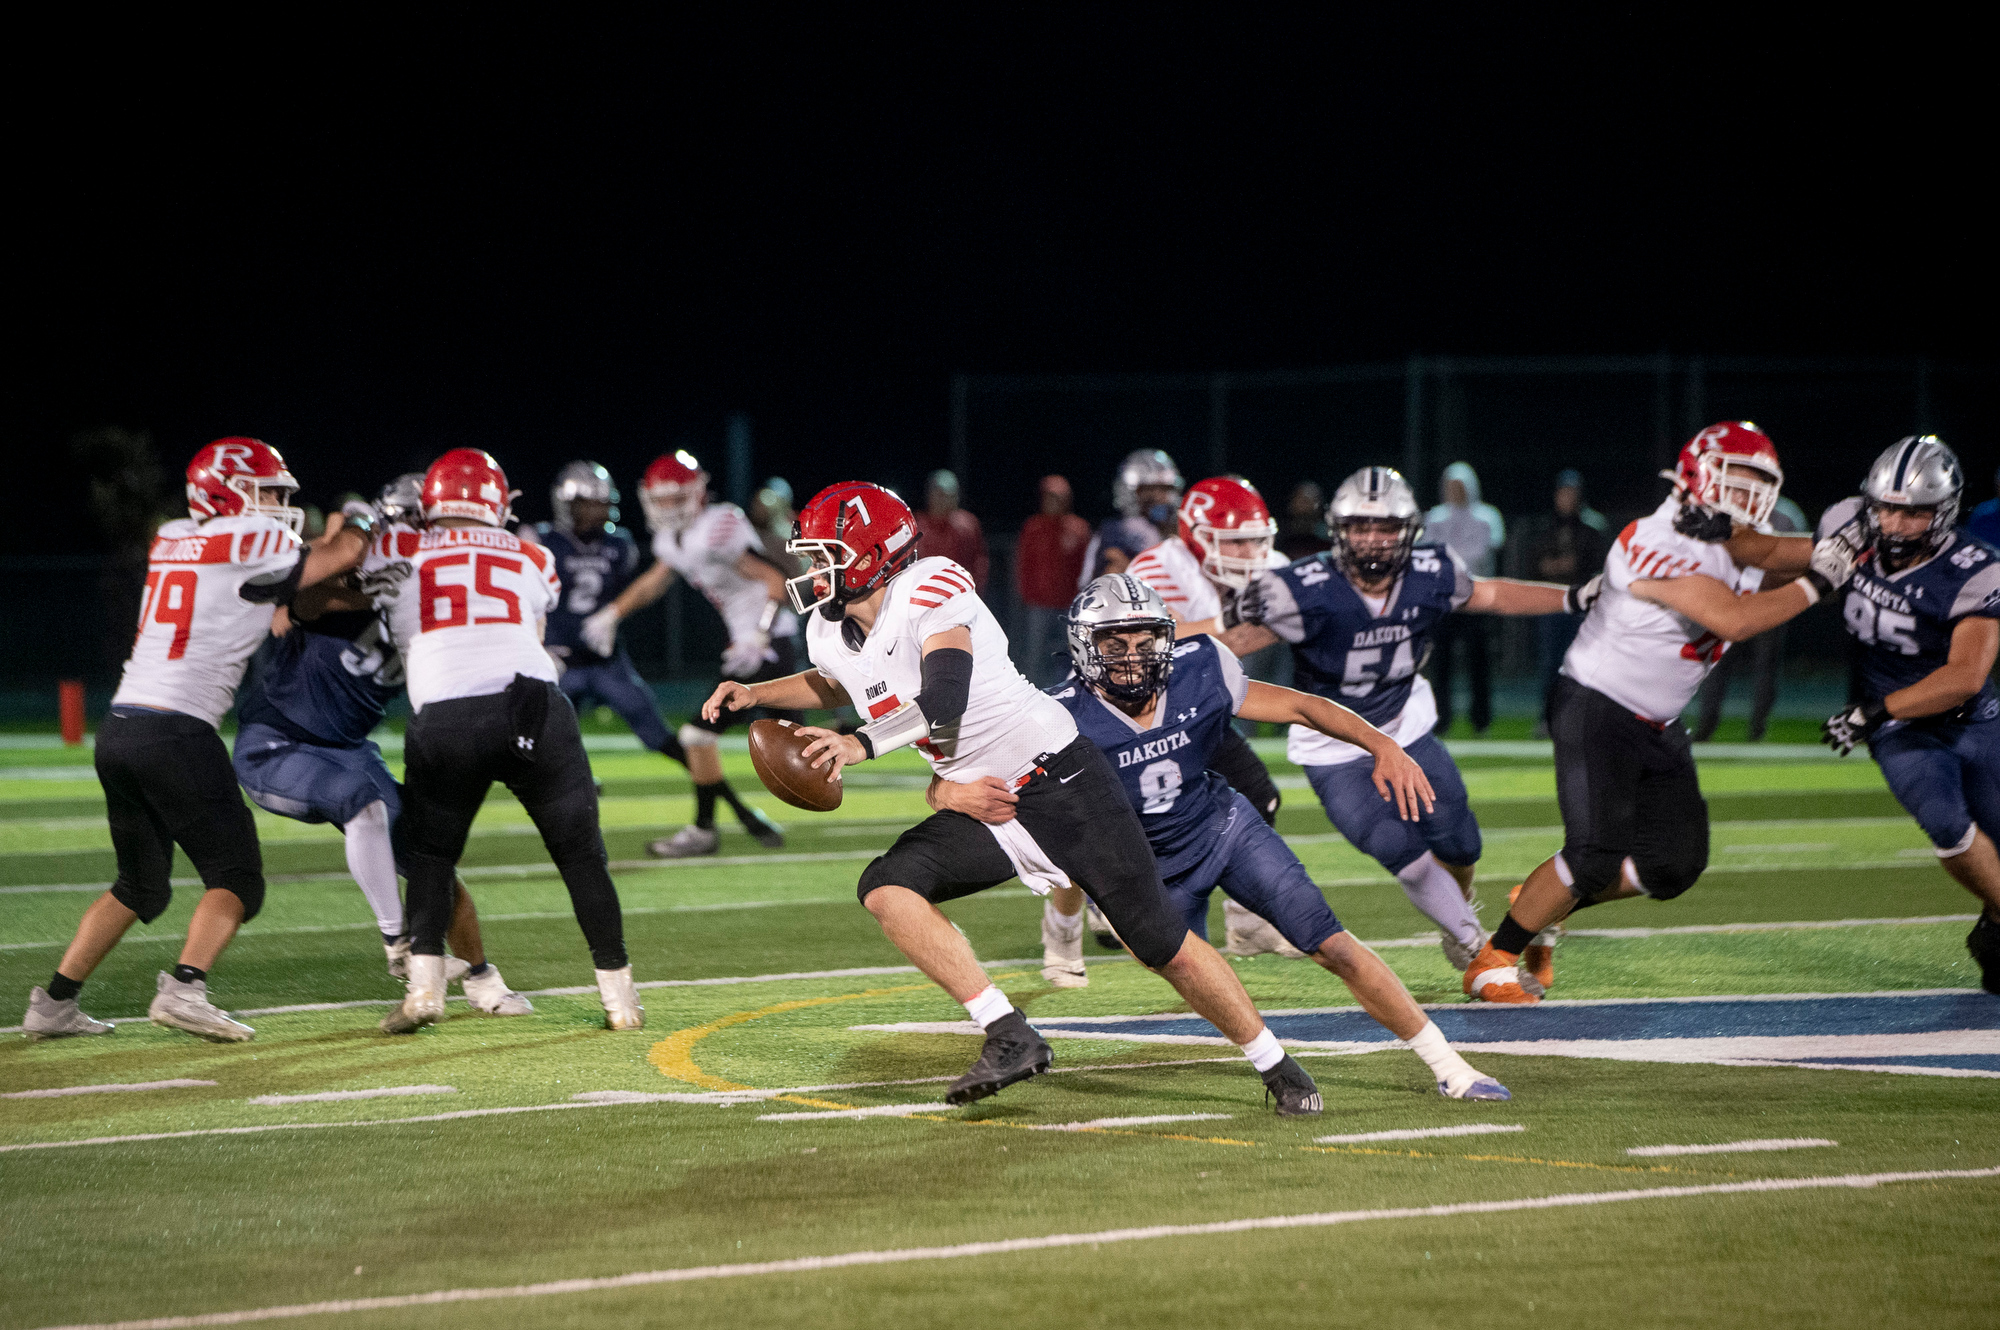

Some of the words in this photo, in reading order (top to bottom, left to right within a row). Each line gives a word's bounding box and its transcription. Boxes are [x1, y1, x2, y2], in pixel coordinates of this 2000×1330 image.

[213, 444, 255, 474] R
[846, 495, 872, 526] 7
[1184, 491, 1215, 525] R
[150, 538, 208, 561] LDOGS
[419, 553, 523, 634] 65
[1852, 574, 1912, 614] DAKOTA
[135, 570, 198, 660] 79
[1843, 591, 1920, 655] 95
[1353, 624, 1414, 649] DAKOTA
[1340, 639, 1416, 698] 54
[865, 680, 888, 700] ROMEO
[1117, 730, 1192, 769] DAKOTA
[1138, 758, 1184, 815] 8
